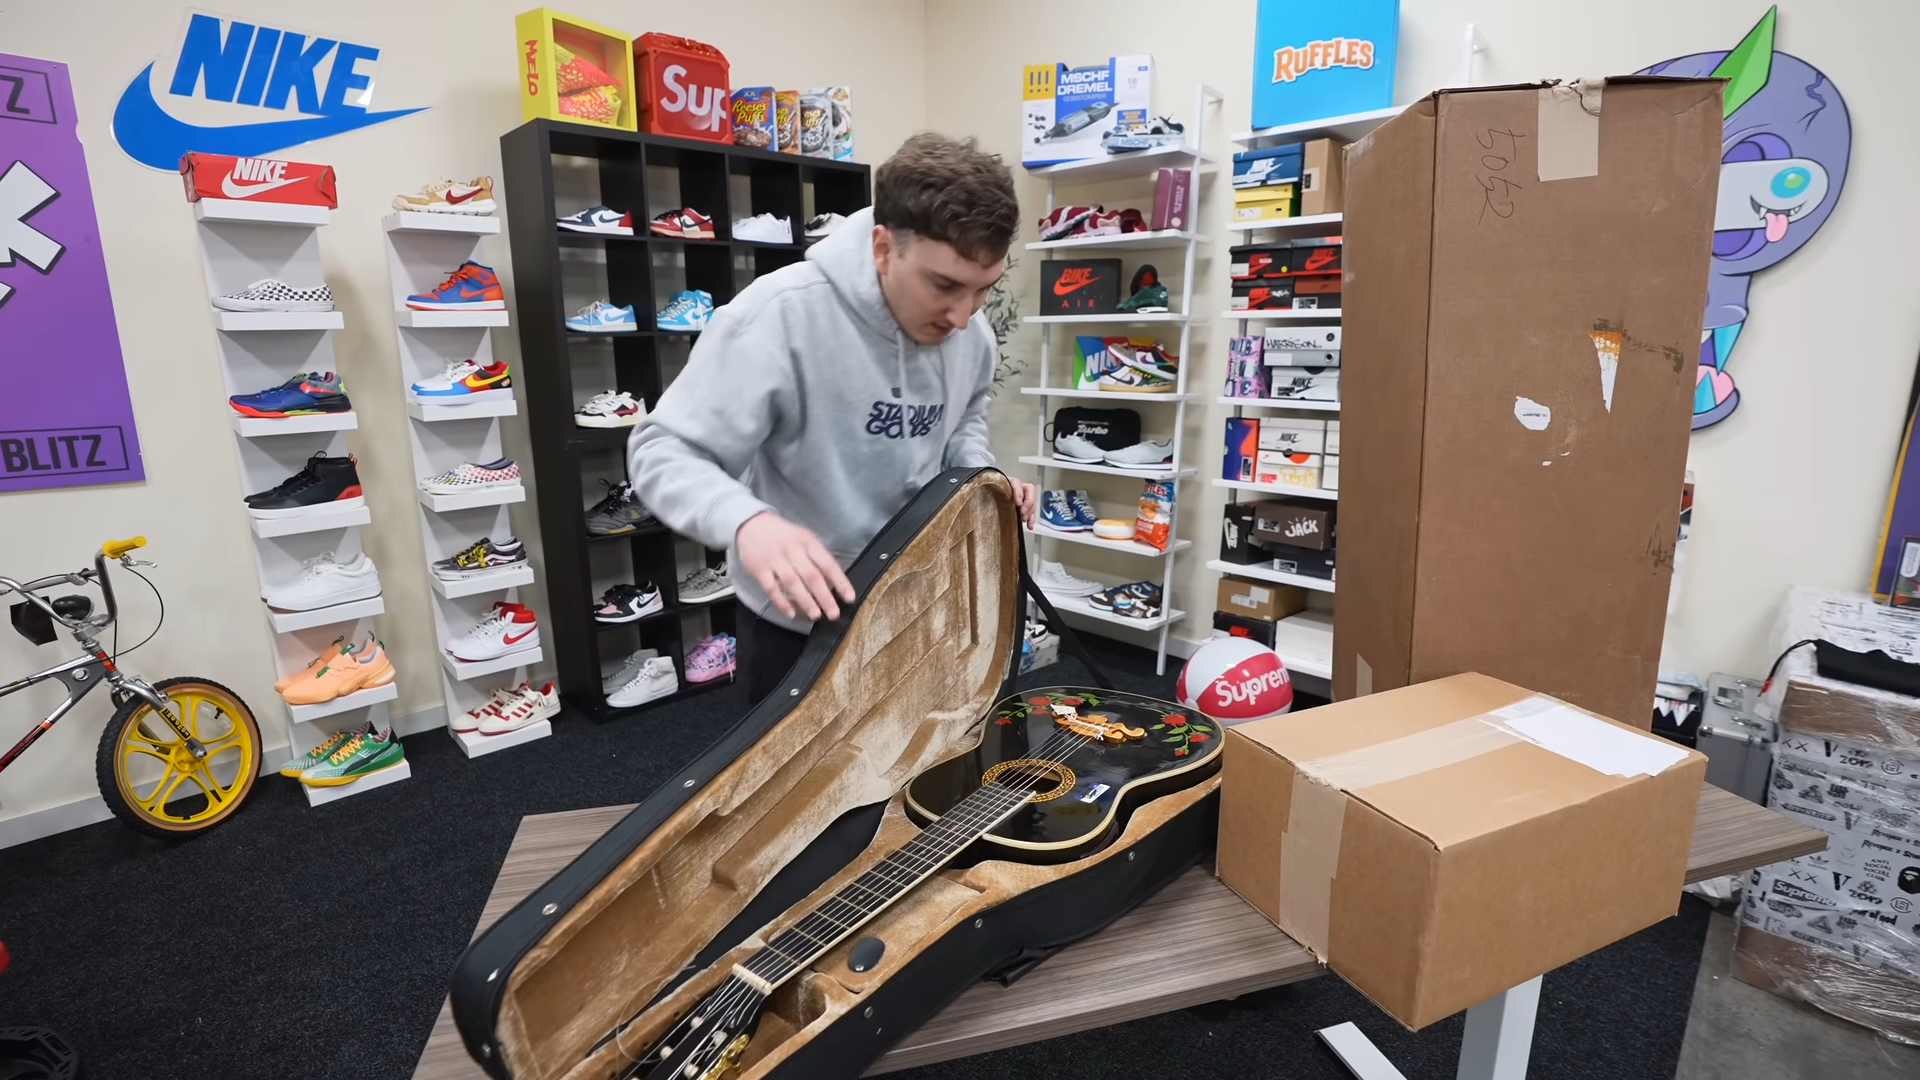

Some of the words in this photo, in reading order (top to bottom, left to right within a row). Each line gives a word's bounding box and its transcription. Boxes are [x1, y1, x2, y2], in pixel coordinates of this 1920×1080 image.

[169, 13, 380, 117] NIKE
[1273, 38, 1375, 83] RUFFLES
[1061, 70, 1110, 84] MSCHF
[1057, 81, 1113, 95] DREMEL
[237, 157, 288, 182] NIKE
[1060, 267, 1092, 283] BIKE
[1061, 300, 1096, 308] AIR
[1086, 349, 1122, 377] NIK
[1291, 377, 1314, 388] NIKE
[1280, 433, 1299, 442] NIKE
[0, 434, 107, 472] BLITZ
[1284, 517, 1319, 537] JACK
[1863, 867, 1890, 878] SOCIAL
[1864, 862, 1891, 871] SOCIAL
[1774, 881, 1836, 907] Supreme
